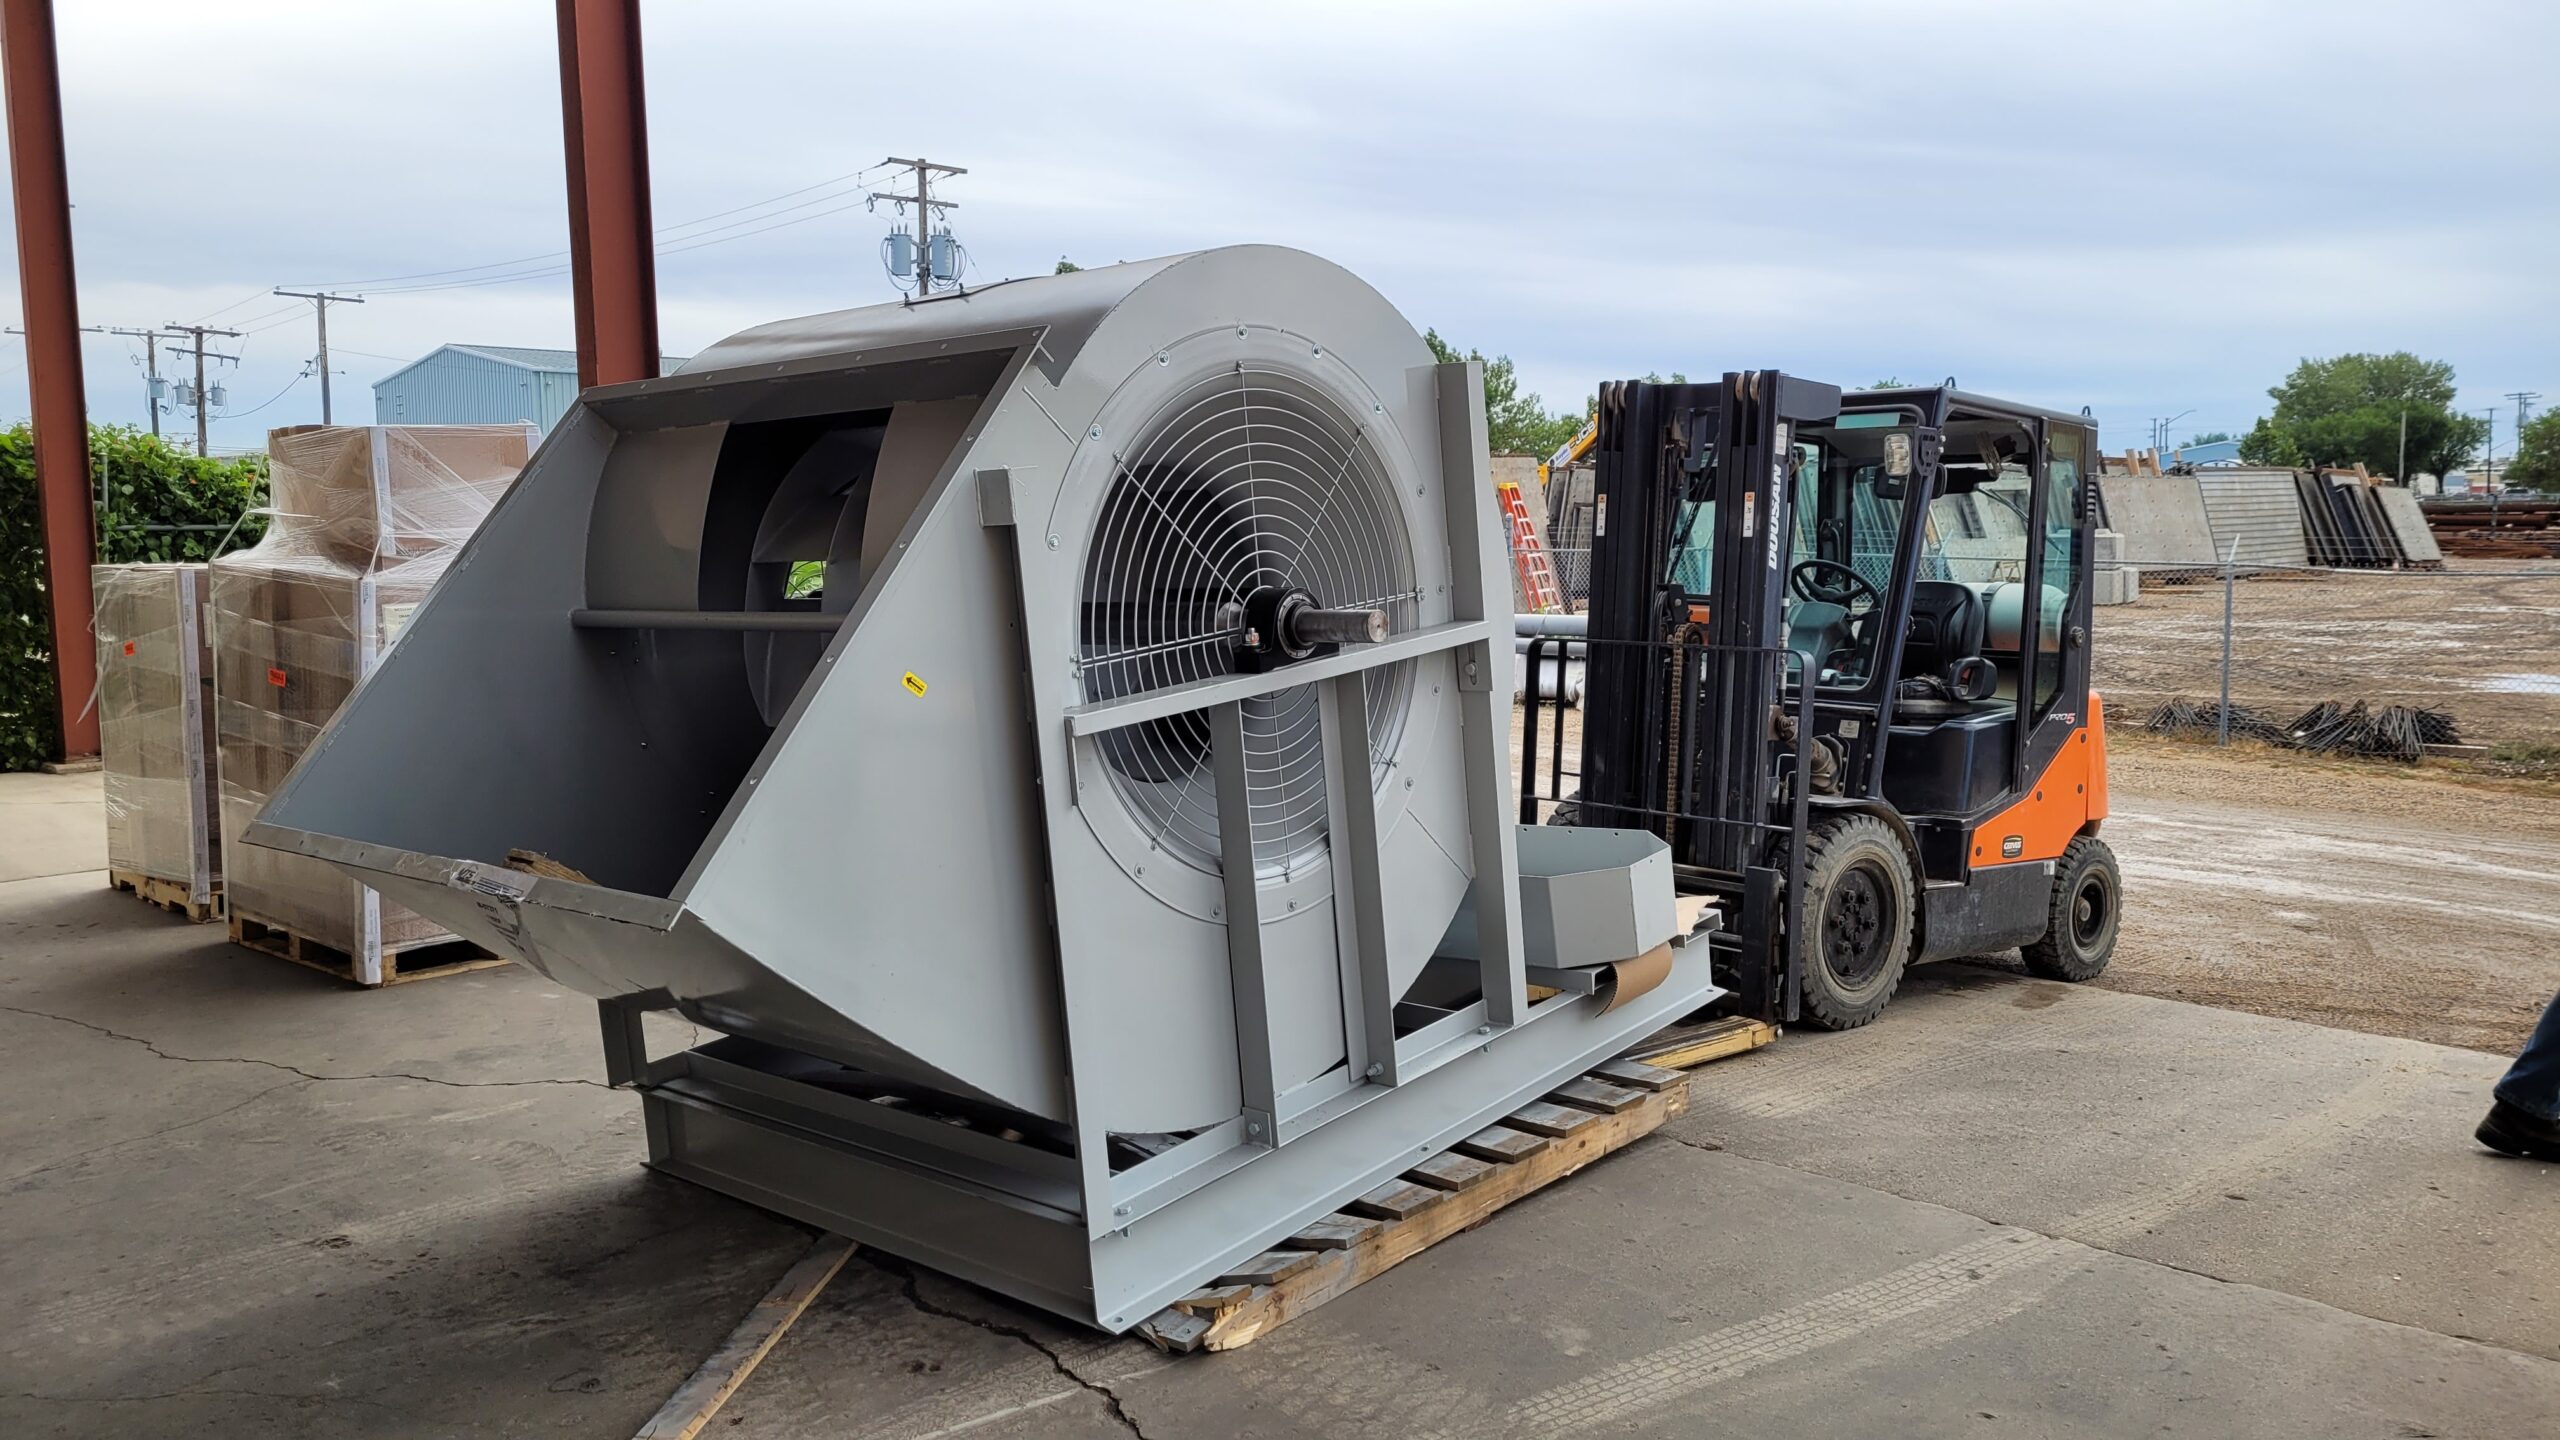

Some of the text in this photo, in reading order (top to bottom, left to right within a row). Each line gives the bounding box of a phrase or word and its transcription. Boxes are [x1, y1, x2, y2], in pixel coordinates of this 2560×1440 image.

[1575, 421, 1595, 444] JCB
[1768, 463, 1782, 571] DOOSAN
[2048, 713, 2076, 725] PRO5
